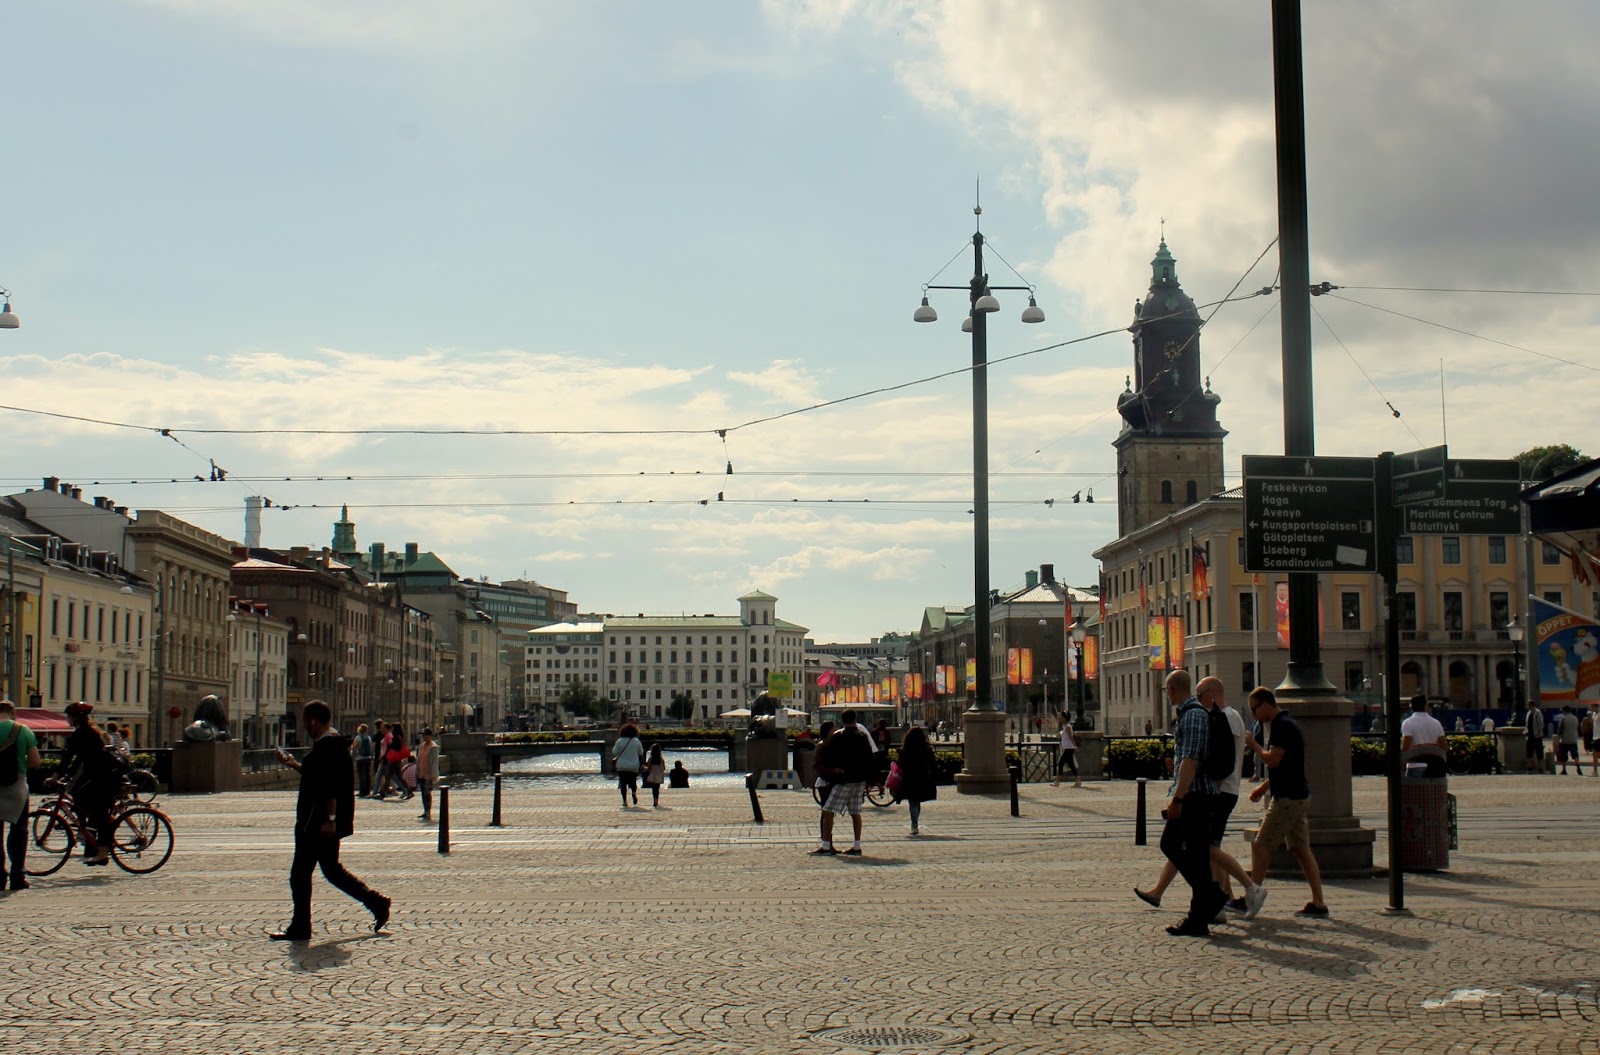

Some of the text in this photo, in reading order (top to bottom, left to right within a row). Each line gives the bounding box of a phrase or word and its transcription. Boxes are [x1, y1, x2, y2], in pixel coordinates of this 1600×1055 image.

[1262, 483, 1328, 494] Feskekyrkan
[1262, 495, 1289, 506] Haga
[1484, 498, 1507, 509] Torg
[1263, 508, 1301, 519] Avenyn
[1410, 509, 1494, 519] Maritimt Centrum
[1262, 520, 1357, 531] Kungsportsplatsen
[1410, 521, 1459, 533] Båtutflykt
[1263, 532, 1325, 543] Götaplatsen
[1263, 545, 1307, 557] Liseberg
[1263, 557, 1334, 567] Scandinavium
